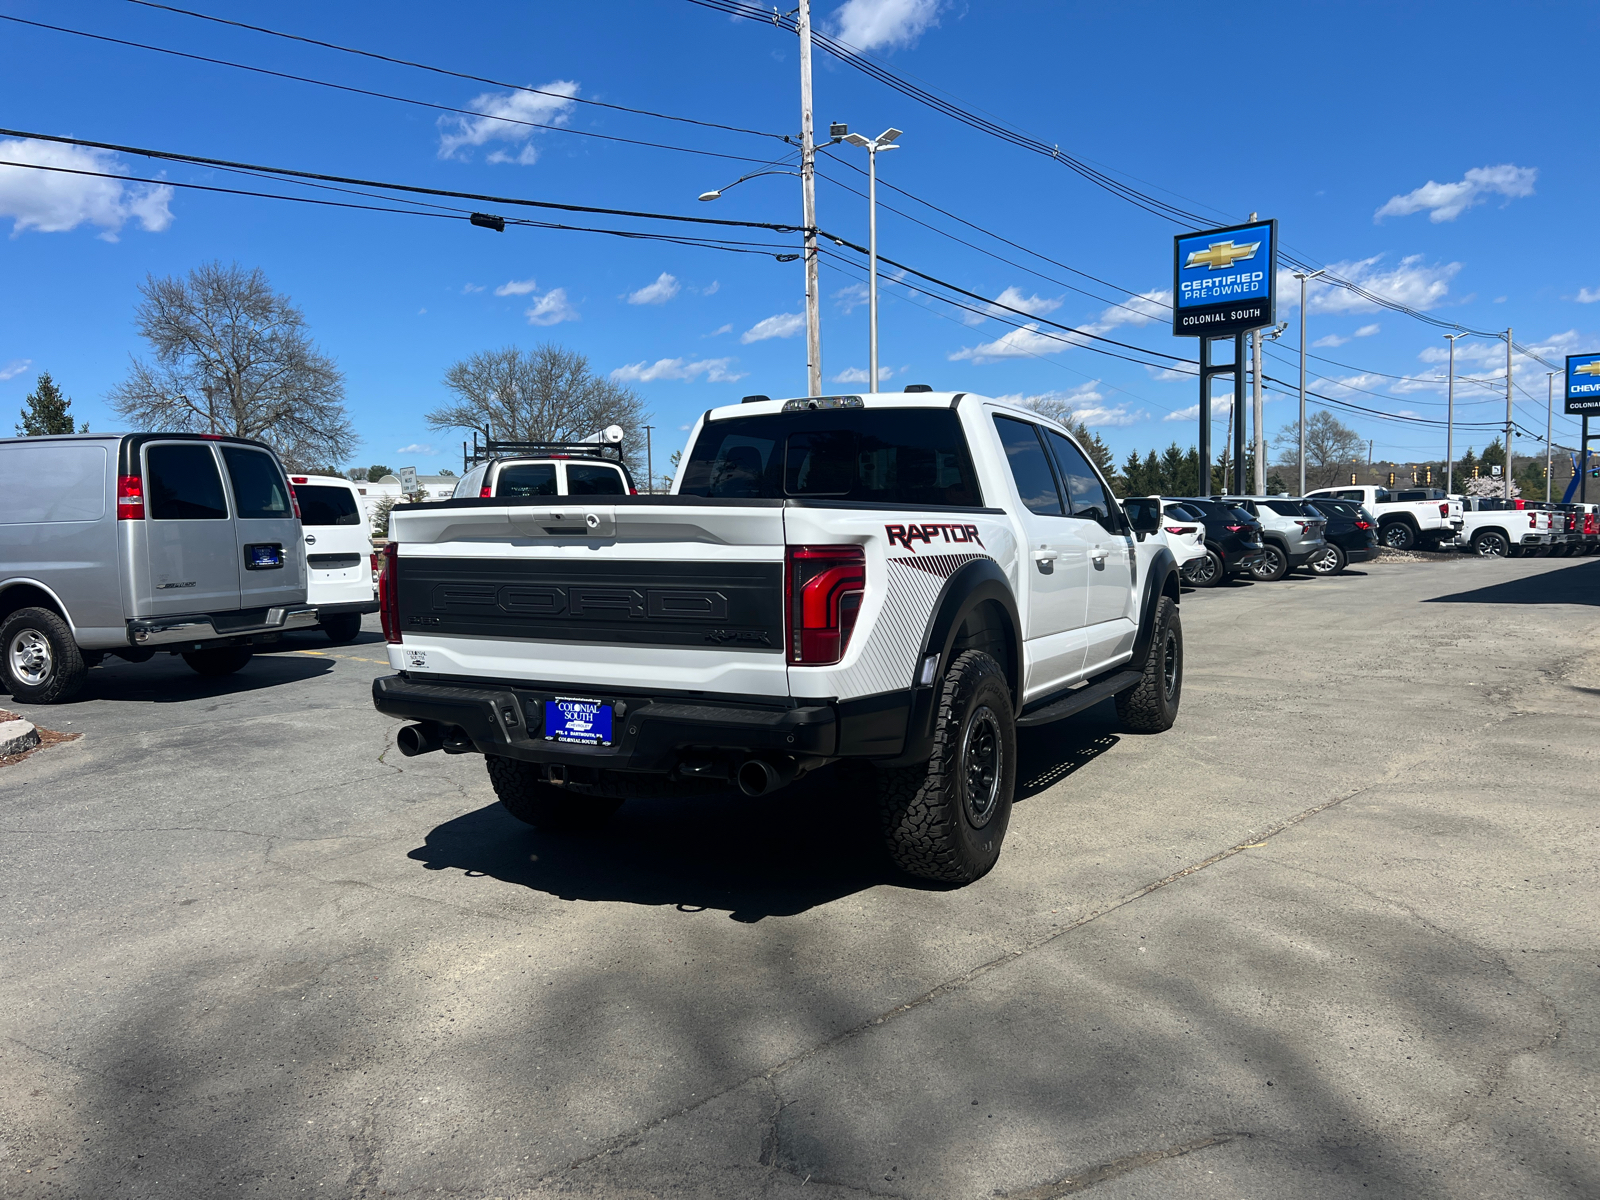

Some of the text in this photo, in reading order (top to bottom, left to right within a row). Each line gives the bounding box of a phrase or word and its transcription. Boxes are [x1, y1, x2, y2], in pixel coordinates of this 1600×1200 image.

[1181, 271, 1263, 291] CERTIFIED
[1185, 282, 1259, 300] PRE-OWNED
[1183, 308, 1261, 325] COLONIAL SOUTH
[884, 523, 986, 554] RAPTOR
[431, 582, 729, 621] FORD
[704, 629, 772, 647] RAPTOR
[558, 702, 600, 713] COLONIAL
[564, 711, 593, 721] SOUTH
